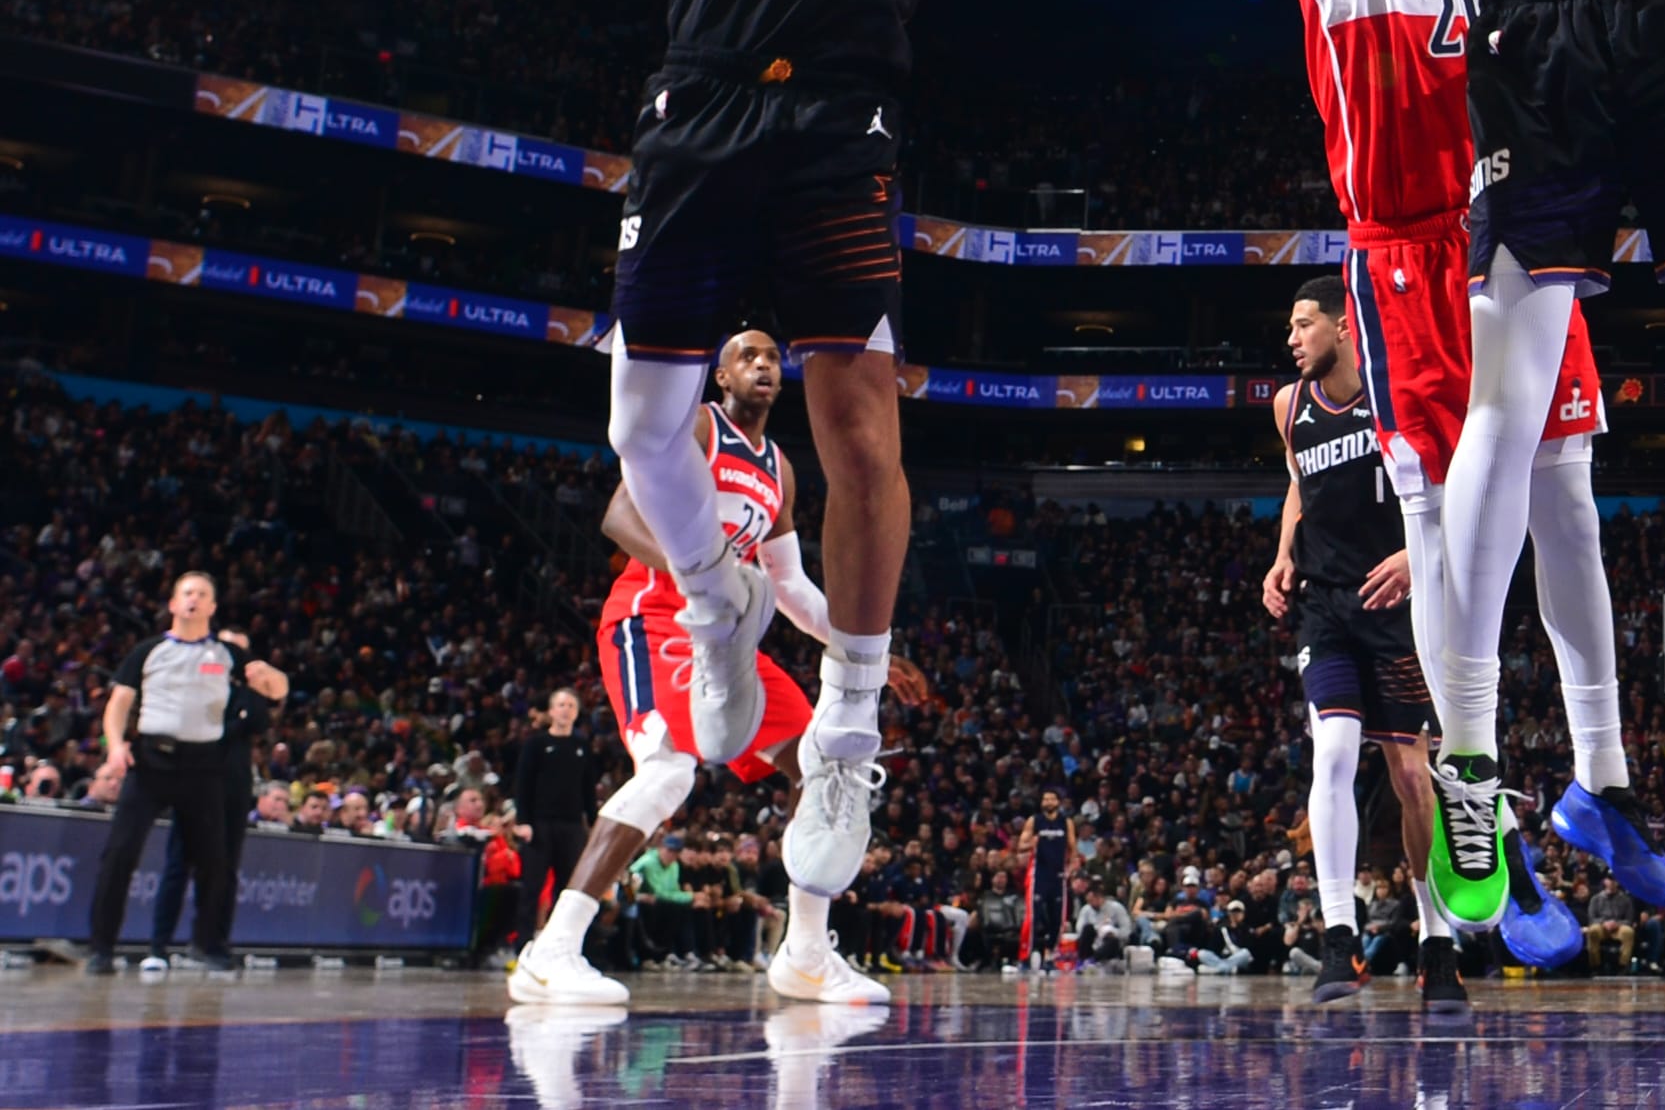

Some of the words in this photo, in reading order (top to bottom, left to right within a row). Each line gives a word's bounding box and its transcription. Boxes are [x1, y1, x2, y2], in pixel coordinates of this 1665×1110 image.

[1470, 148, 1510, 206] UNS
[48, 237, 128, 265] ULTRA
[265, 272, 337, 297] ULTRA
[463, 304, 530, 329] ULTRA
[980, 383, 1040, 401] ULTRA
[1150, 384, 1211, 401] ULTRA
[1295, 428, 1380, 477] PHOENIX
[1375, 466, 1385, 503] 1
[0, 850, 73, 917] aps
[387, 876, 436, 926] aps
